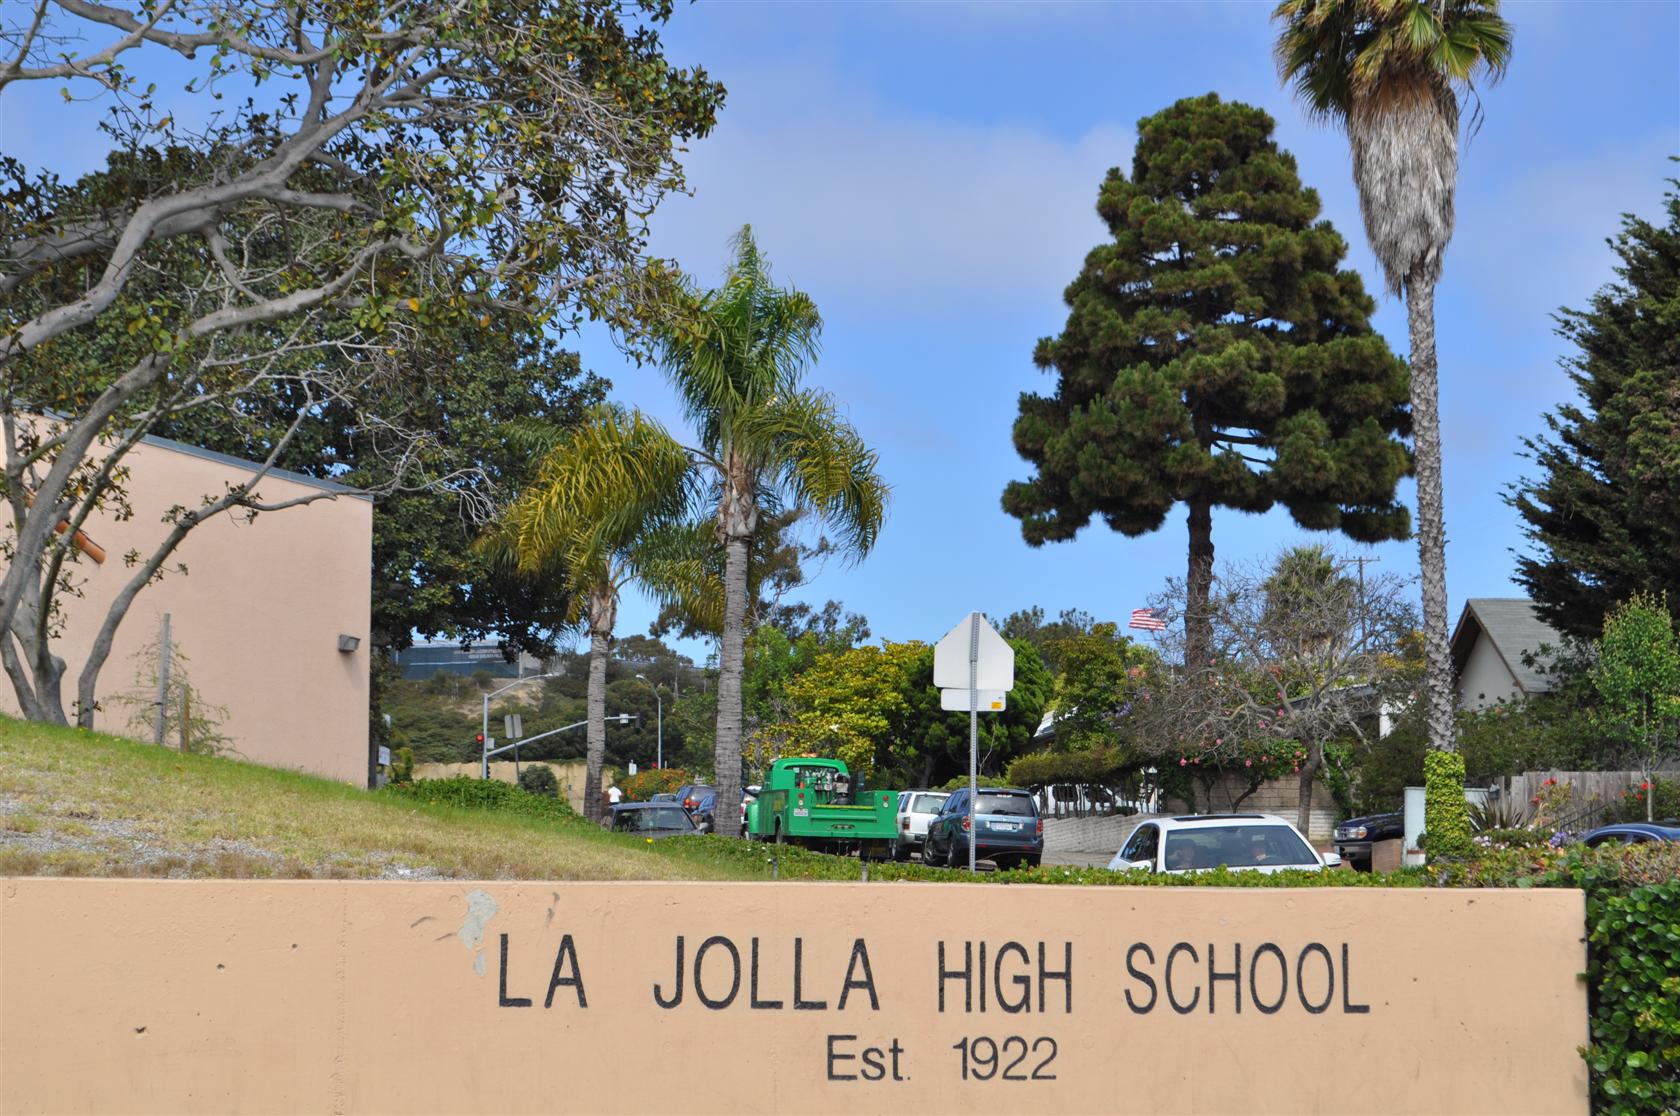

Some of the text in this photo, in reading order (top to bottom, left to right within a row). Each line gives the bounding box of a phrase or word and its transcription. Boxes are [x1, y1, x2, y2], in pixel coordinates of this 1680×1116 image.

[499, 933, 1370, 1015] LA JOLLA HIGH SCHOOL
[827, 1034, 1058, 1081] Est. 1922
